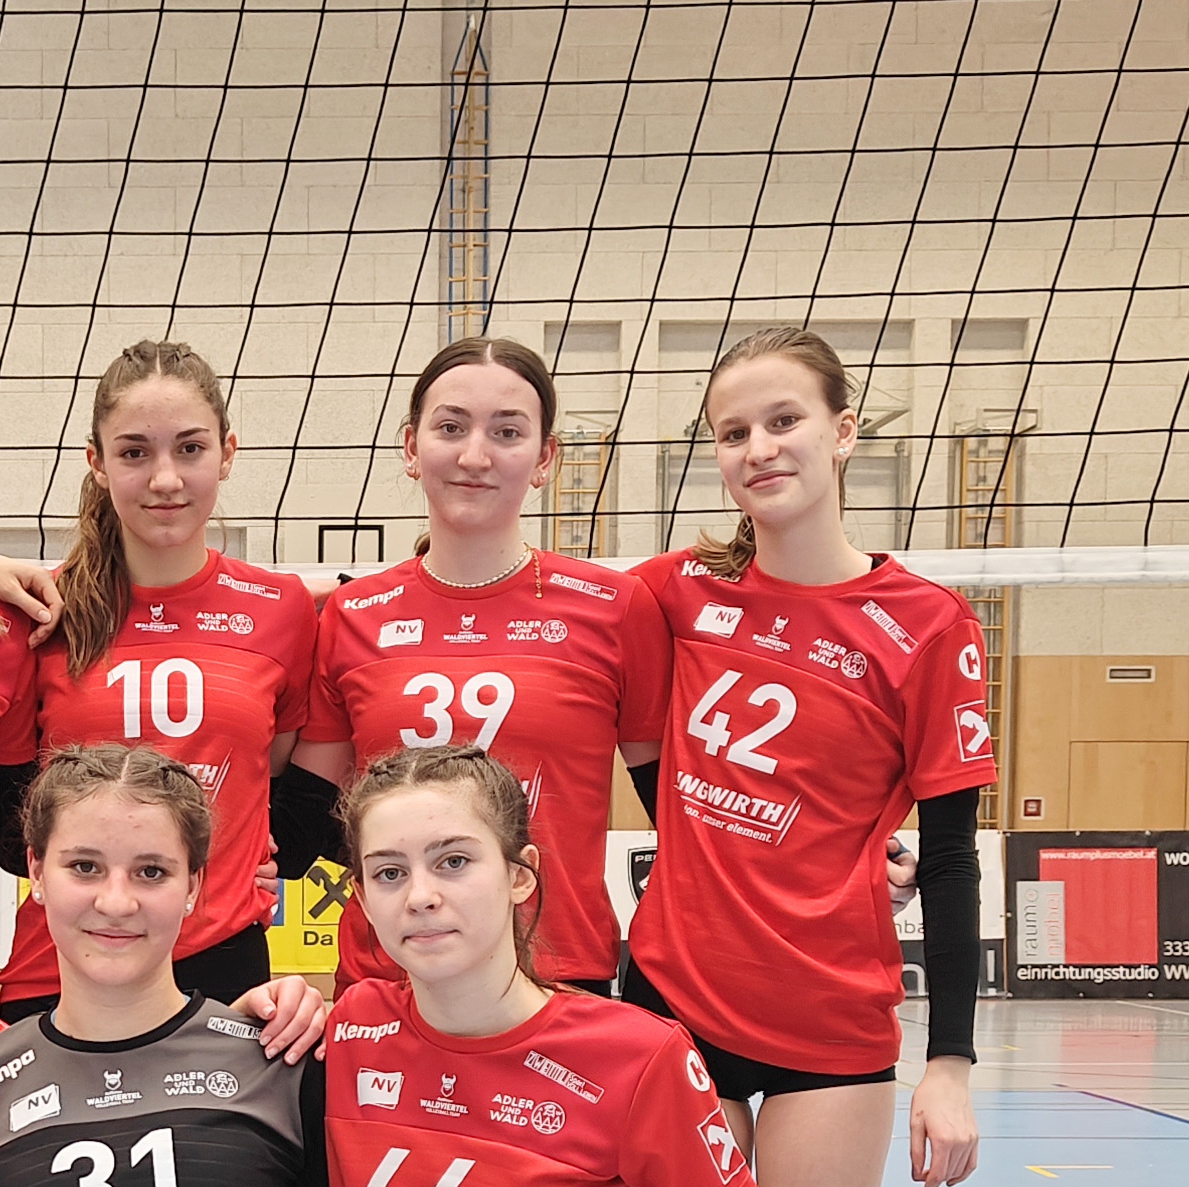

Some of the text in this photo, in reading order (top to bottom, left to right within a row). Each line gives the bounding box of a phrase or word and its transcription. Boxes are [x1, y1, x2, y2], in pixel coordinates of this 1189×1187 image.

[343, 585, 404, 610] Kempa
[196, 612, 228, 620] ADLER
[507, 620, 542, 628] ADLER
[715, 611, 736, 623] NV
[197, 623, 228, 632] WALD
[395, 624, 418, 634] NV
[813, 638, 847, 656] ADLER
[818, 648, 835, 658] UND
[808, 650, 839, 668] WALD
[107, 658, 204, 738] 10
[399, 672, 515, 752] 39
[687, 669, 797, 775] 42
[674, 771, 785, 822] NGWIRTH
[1017, 965, 1159, 983] einrichtungsstudio
[333, 1020, 400, 1043] Kempa
[163, 1071, 205, 1083] ADLER
[371, 1076, 397, 1093] NV
[86, 1092, 143, 1106] WALDVIERTEL
[164, 1086, 205, 1096] WALD
[27, 1093, 54, 1110] NV
[420, 1098, 468, 1114] WALDVIERTEL
[492, 1094, 534, 1110] ADLER
[489, 1110, 528, 1126] WALD
[501, 1105, 521, 1115] UND
